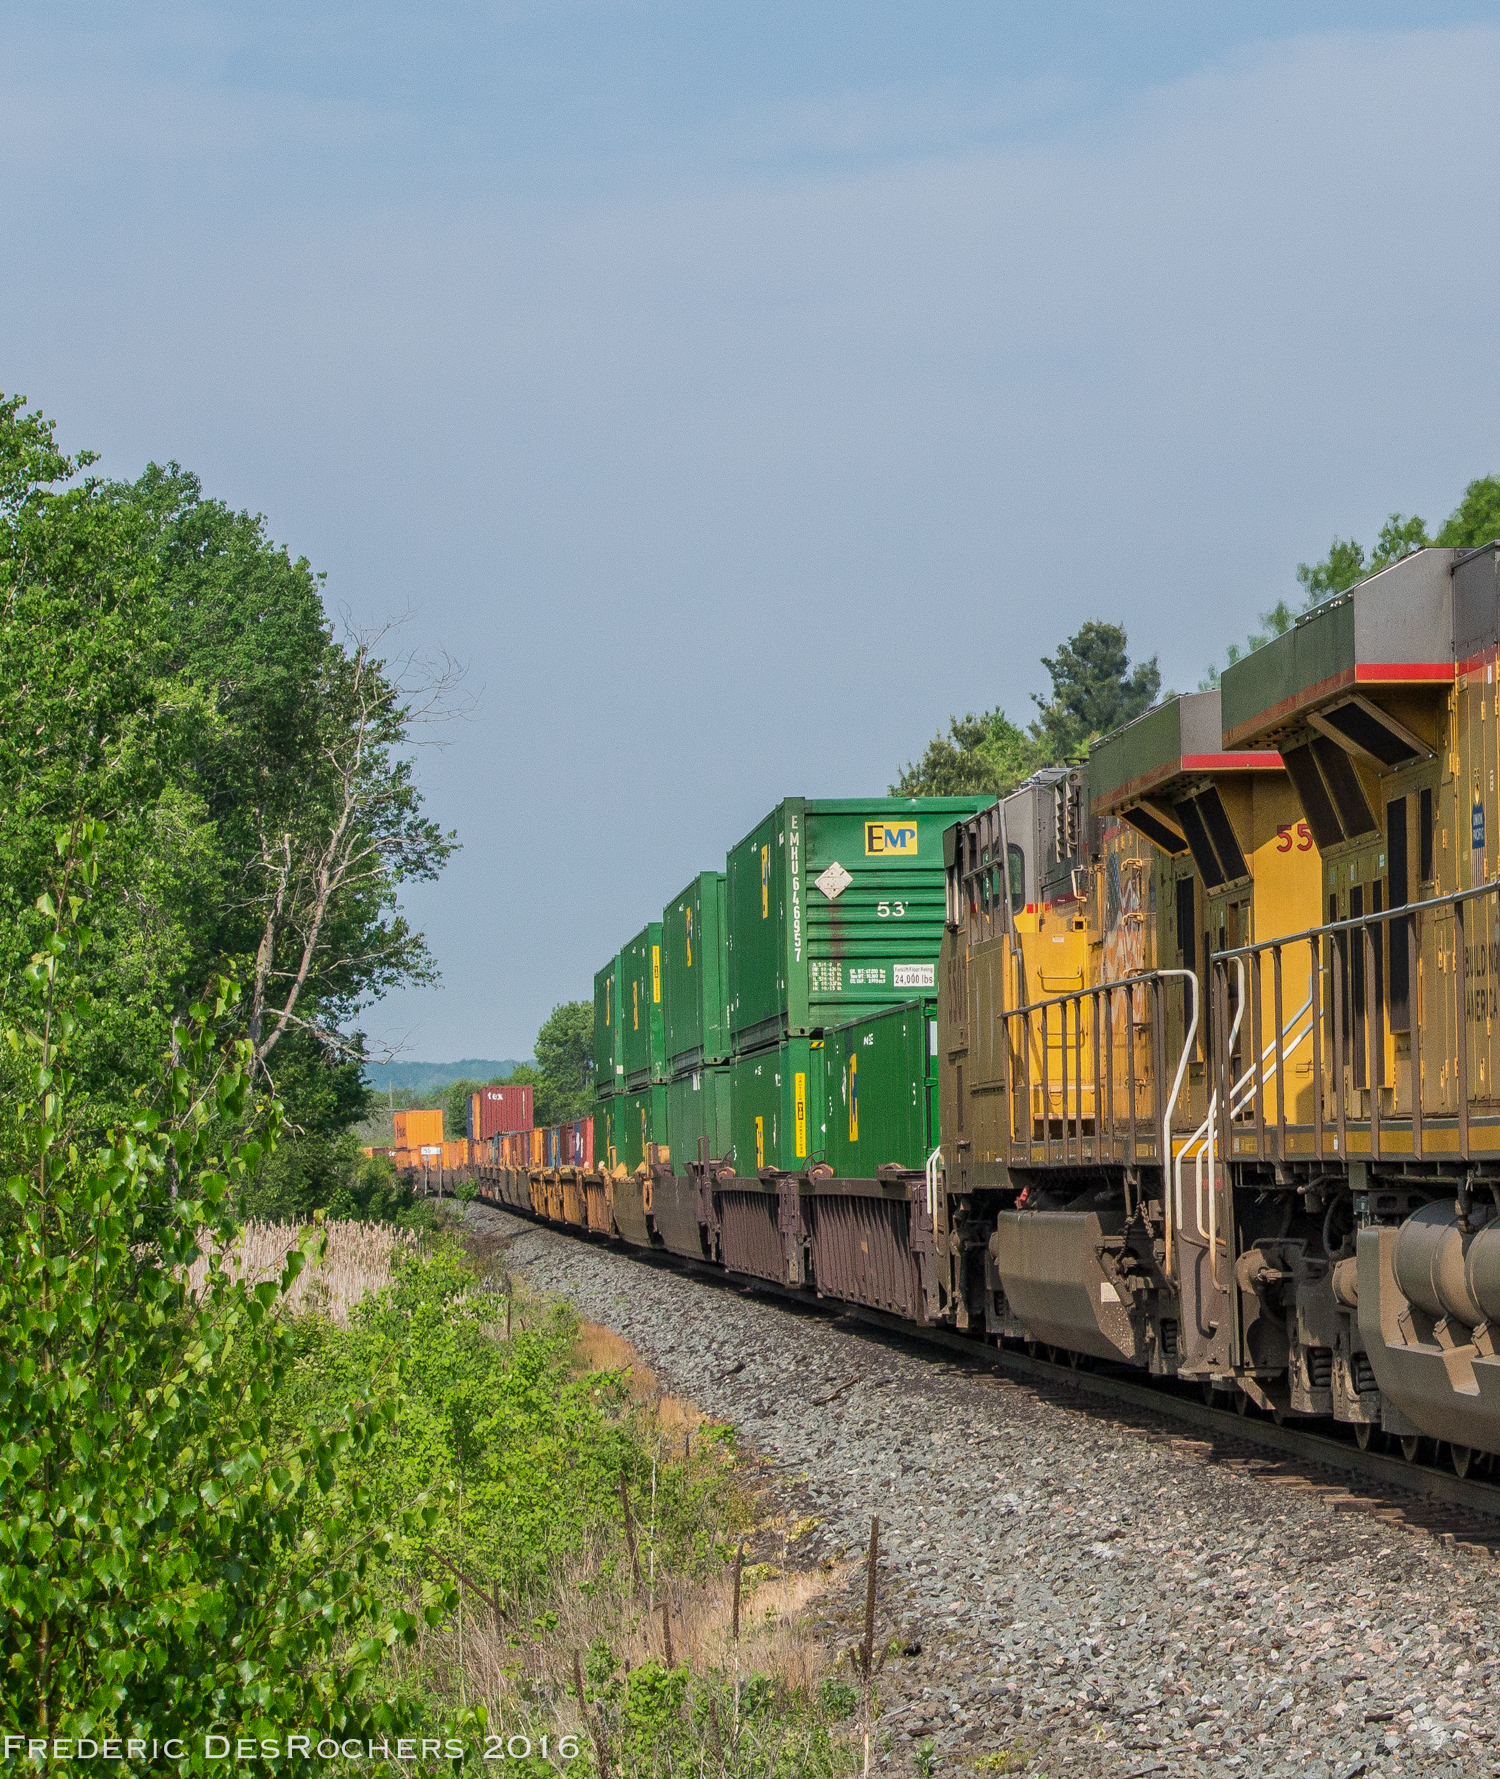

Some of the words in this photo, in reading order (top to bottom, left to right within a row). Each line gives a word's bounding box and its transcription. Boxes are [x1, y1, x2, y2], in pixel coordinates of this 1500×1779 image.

[867, 825, 916, 852] EMP
[877, 901, 909, 918] 53'
[1465, 942, 1498, 978] BUILDNG
[895, 974, 920, 985] 24,000
[921, 974, 933, 984] lbs
